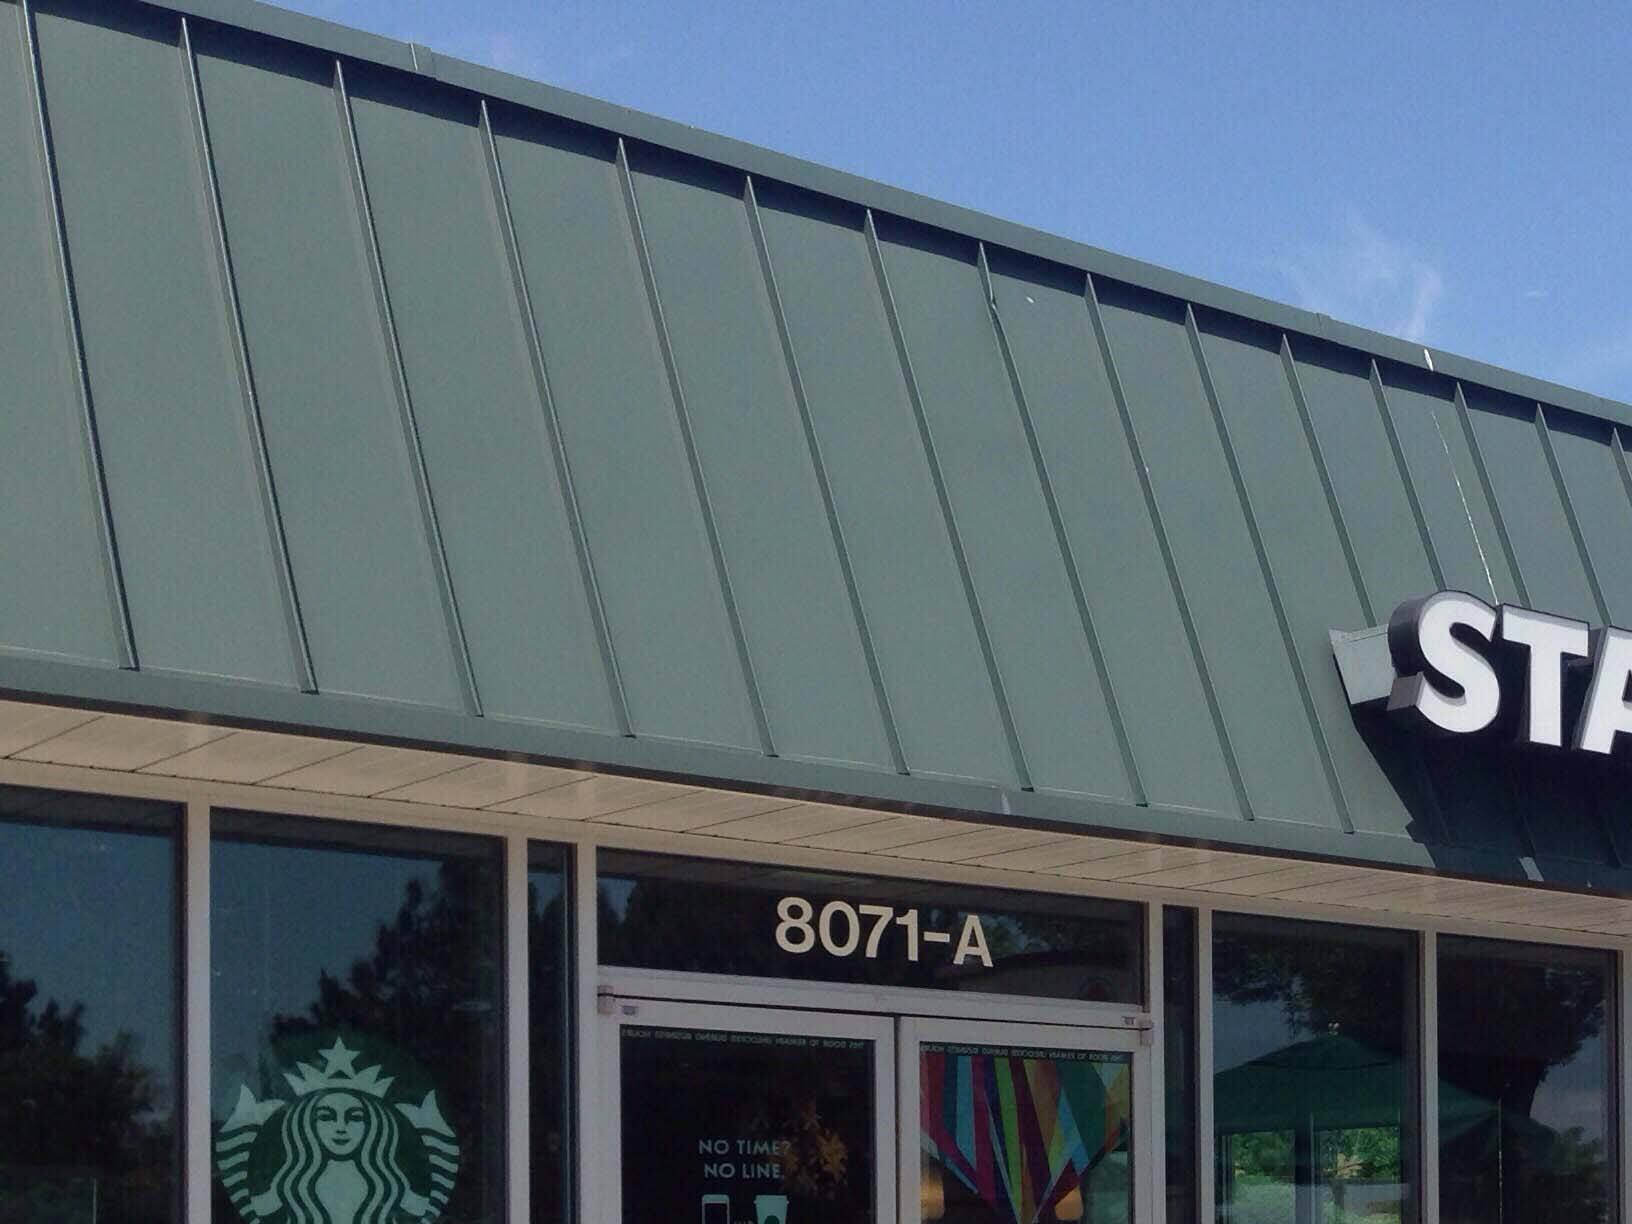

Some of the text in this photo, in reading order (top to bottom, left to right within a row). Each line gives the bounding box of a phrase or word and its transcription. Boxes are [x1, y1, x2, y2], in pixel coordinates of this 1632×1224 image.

[775, 896, 994, 967] 8071-A
[699, 1140, 791, 1155] NO TIME?
[704, 1163, 735, 1178] NO
